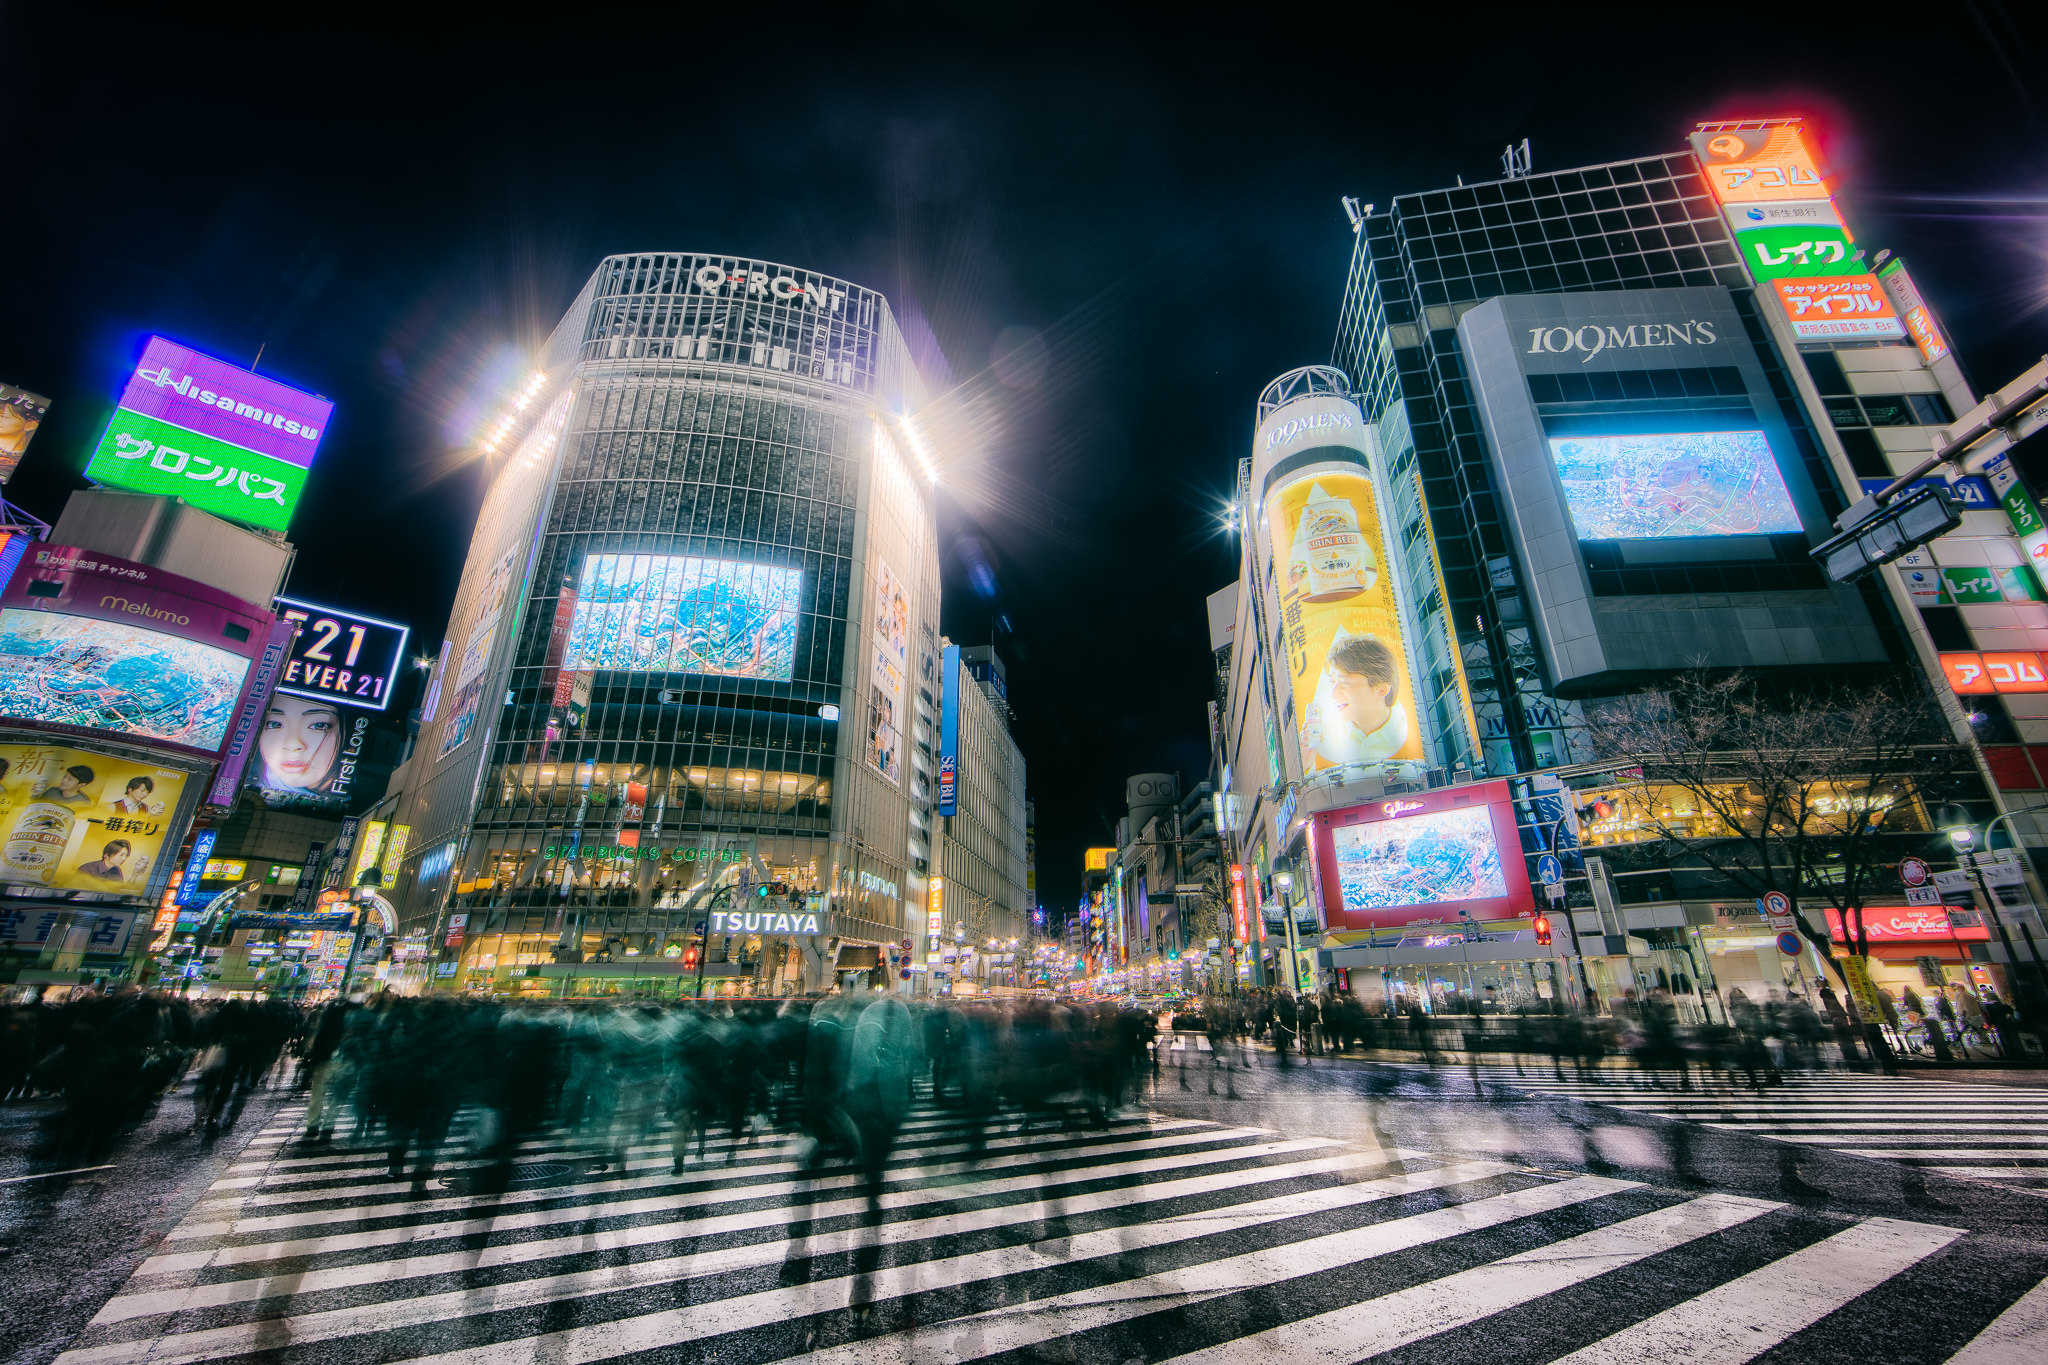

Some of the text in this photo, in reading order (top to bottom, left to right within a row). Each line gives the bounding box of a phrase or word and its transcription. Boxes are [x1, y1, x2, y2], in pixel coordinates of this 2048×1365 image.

[1722, 164, 1822, 188] アコム
[1767, 207, 1817, 219] 新生銀行
[1754, 240, 1845, 266] レイク
[695, 265, 846, 312] QFRONT
[1783, 282, 1873, 295] キャッシングなら
[1787, 293, 1883, 316] アイフル
[1798, 321, 1896, 336] 新規会員募集中 8F
[137, 367, 319, 441] Hisamitsu
[115, 432, 286, 507] サロンパス
[2009, 497, 2033, 527] レイク
[1336, 535, 1358, 545] BEER
[50, 556, 147, 580] わかさ生活 チャンネル
[1905, 555, 1920, 564] 6F
[1947, 577, 2000, 594] レイク
[1283, 587, 1307, 678] 一番搾り
[1954, 662, 2047, 686] アコム
[354, 674, 385, 699] 21
[229, 703, 259, 757] neon
[330, 716, 369, 794] First Love
[156, 769, 182, 780] KIRIN
[1382, 800, 1426, 818] Glico
[11, 832, 41, 840] KIRIN
[87, 815, 160, 836] 一番搾り
[325, 819, 358, 887] 洋服の青山
[543, 845, 743, 863] STARBUCKS COFFEE
[711, 911, 820, 933] TSUTAYA
